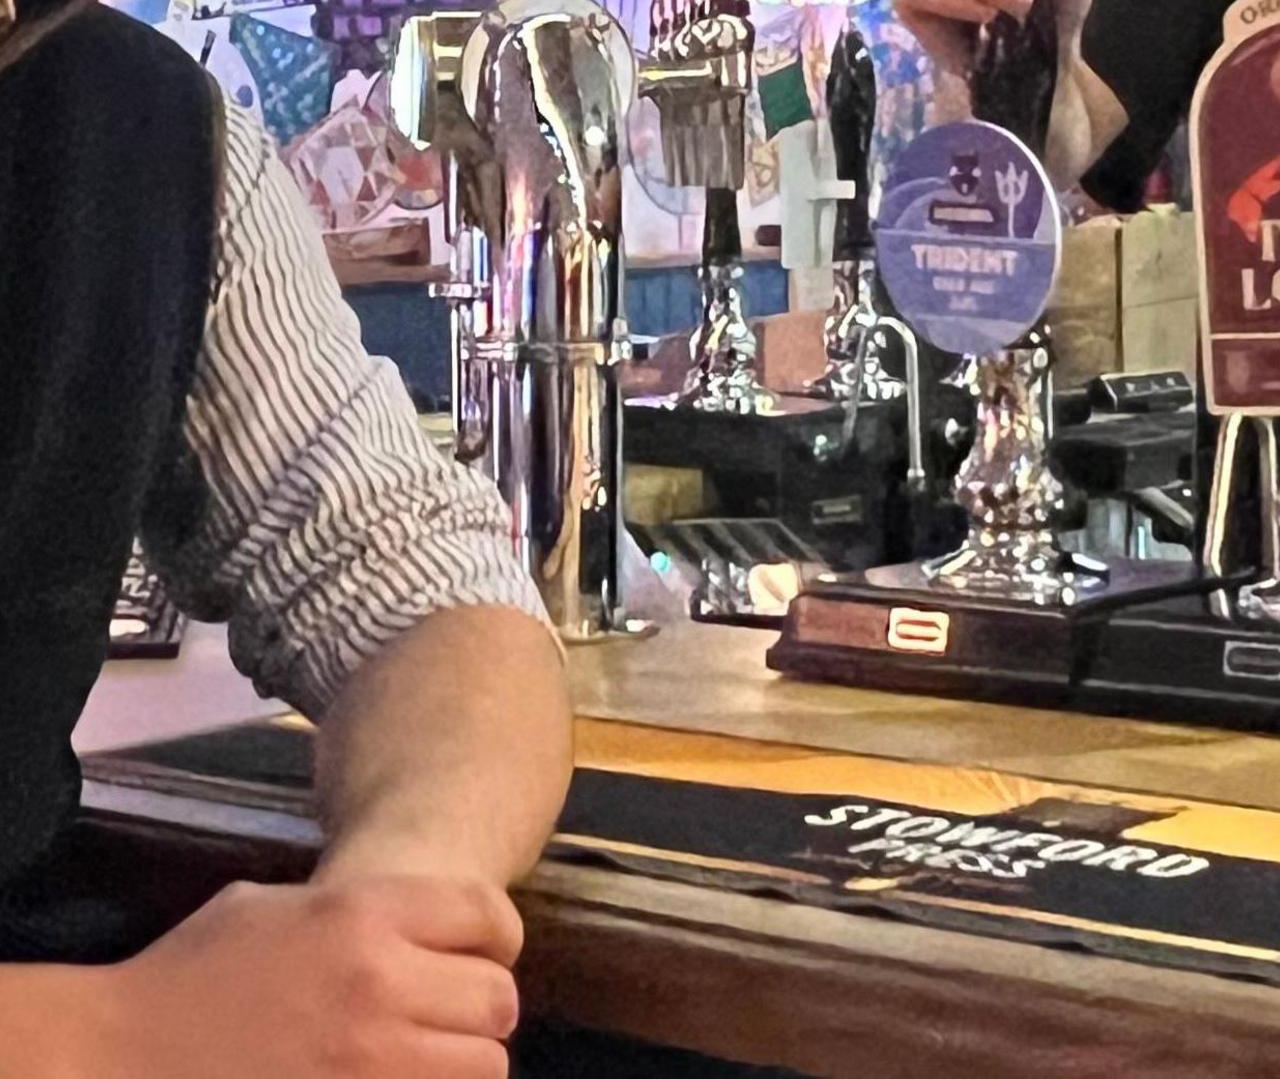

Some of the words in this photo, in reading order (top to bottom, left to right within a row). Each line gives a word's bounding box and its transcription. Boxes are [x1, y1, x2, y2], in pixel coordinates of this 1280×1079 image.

[910, 243, 1019, 276] TRIDENT
[804, 804, 1211, 879] STOWFORD
[848, 837, 1047, 879] PRESS
